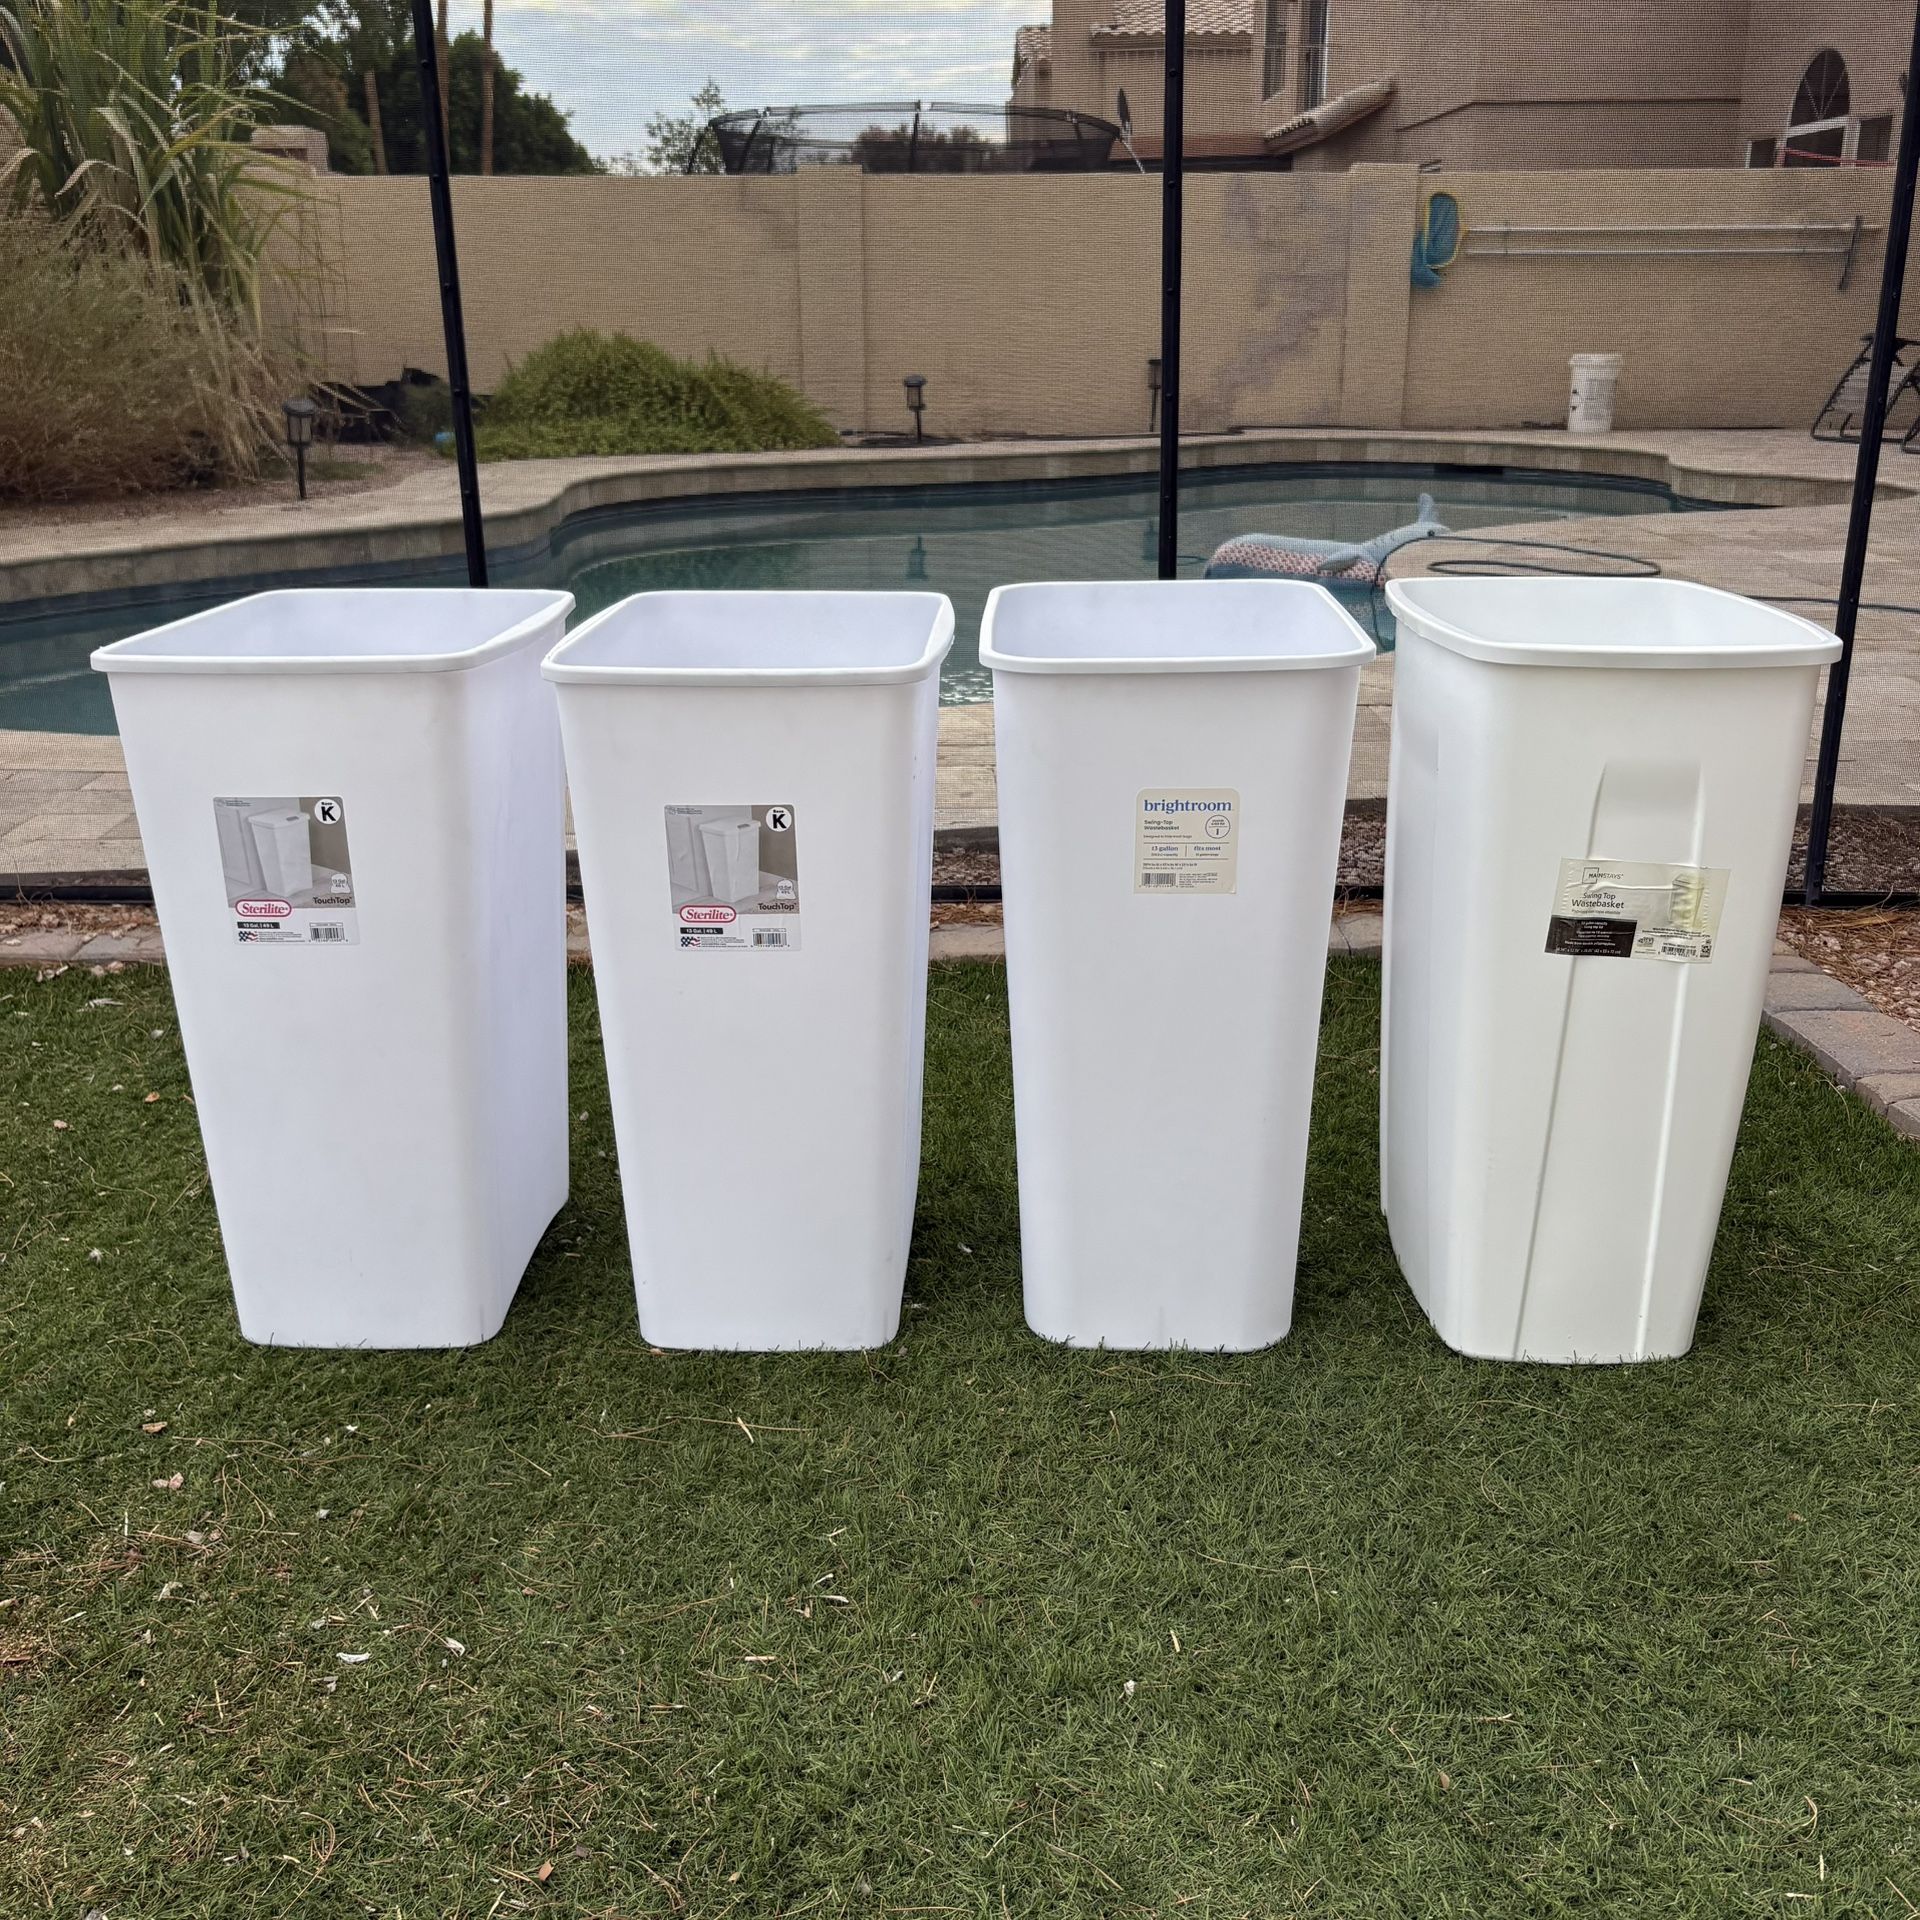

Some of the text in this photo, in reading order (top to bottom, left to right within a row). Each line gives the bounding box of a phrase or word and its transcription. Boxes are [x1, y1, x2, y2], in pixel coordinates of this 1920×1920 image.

[1143, 799, 1231, 814] brightroom
[321, 806, 336, 821] K
[773, 814, 787, 828] K
[1588, 872, 1621, 880] MAINSTAYS
[1583, 892, 1616, 901] Swing Top
[242, 903, 285, 914] Sterilite
[1571, 899, 1625, 909] Wastebasket
[686, 908, 730, 920] Sterilite
